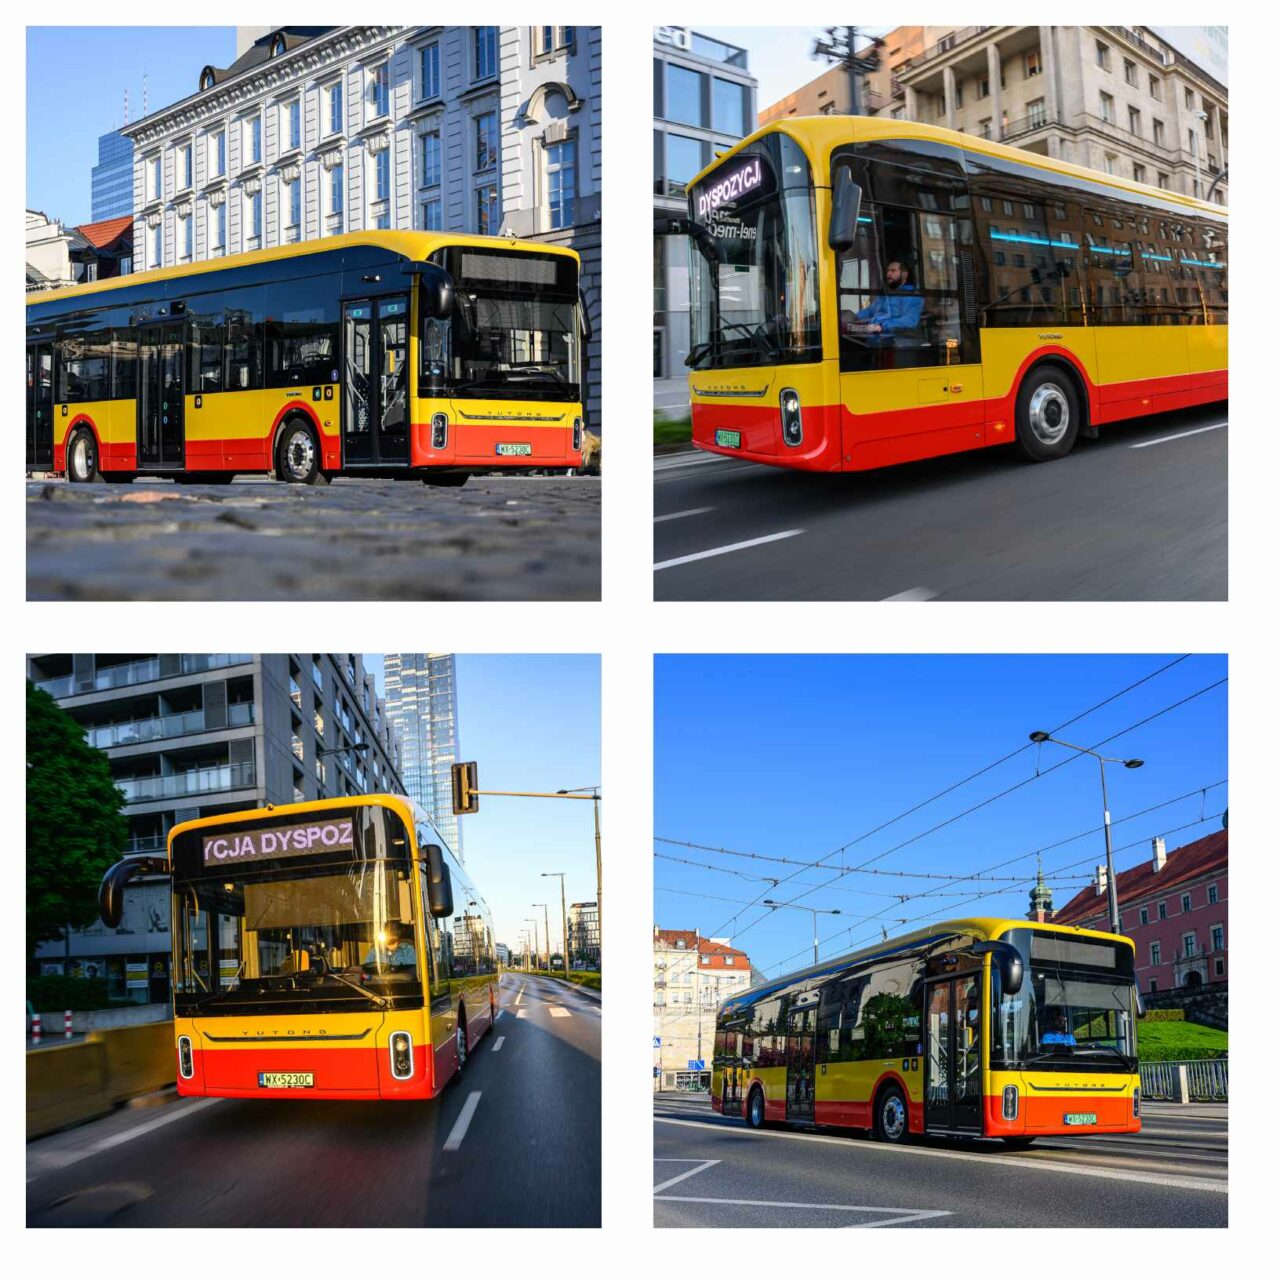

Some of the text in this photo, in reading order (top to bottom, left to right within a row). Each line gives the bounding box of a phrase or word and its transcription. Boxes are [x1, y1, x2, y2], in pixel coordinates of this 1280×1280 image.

[699, 161, 761, 215] DYSPOZYCJ
[265, 1075, 311, 1084] WX 5230C
